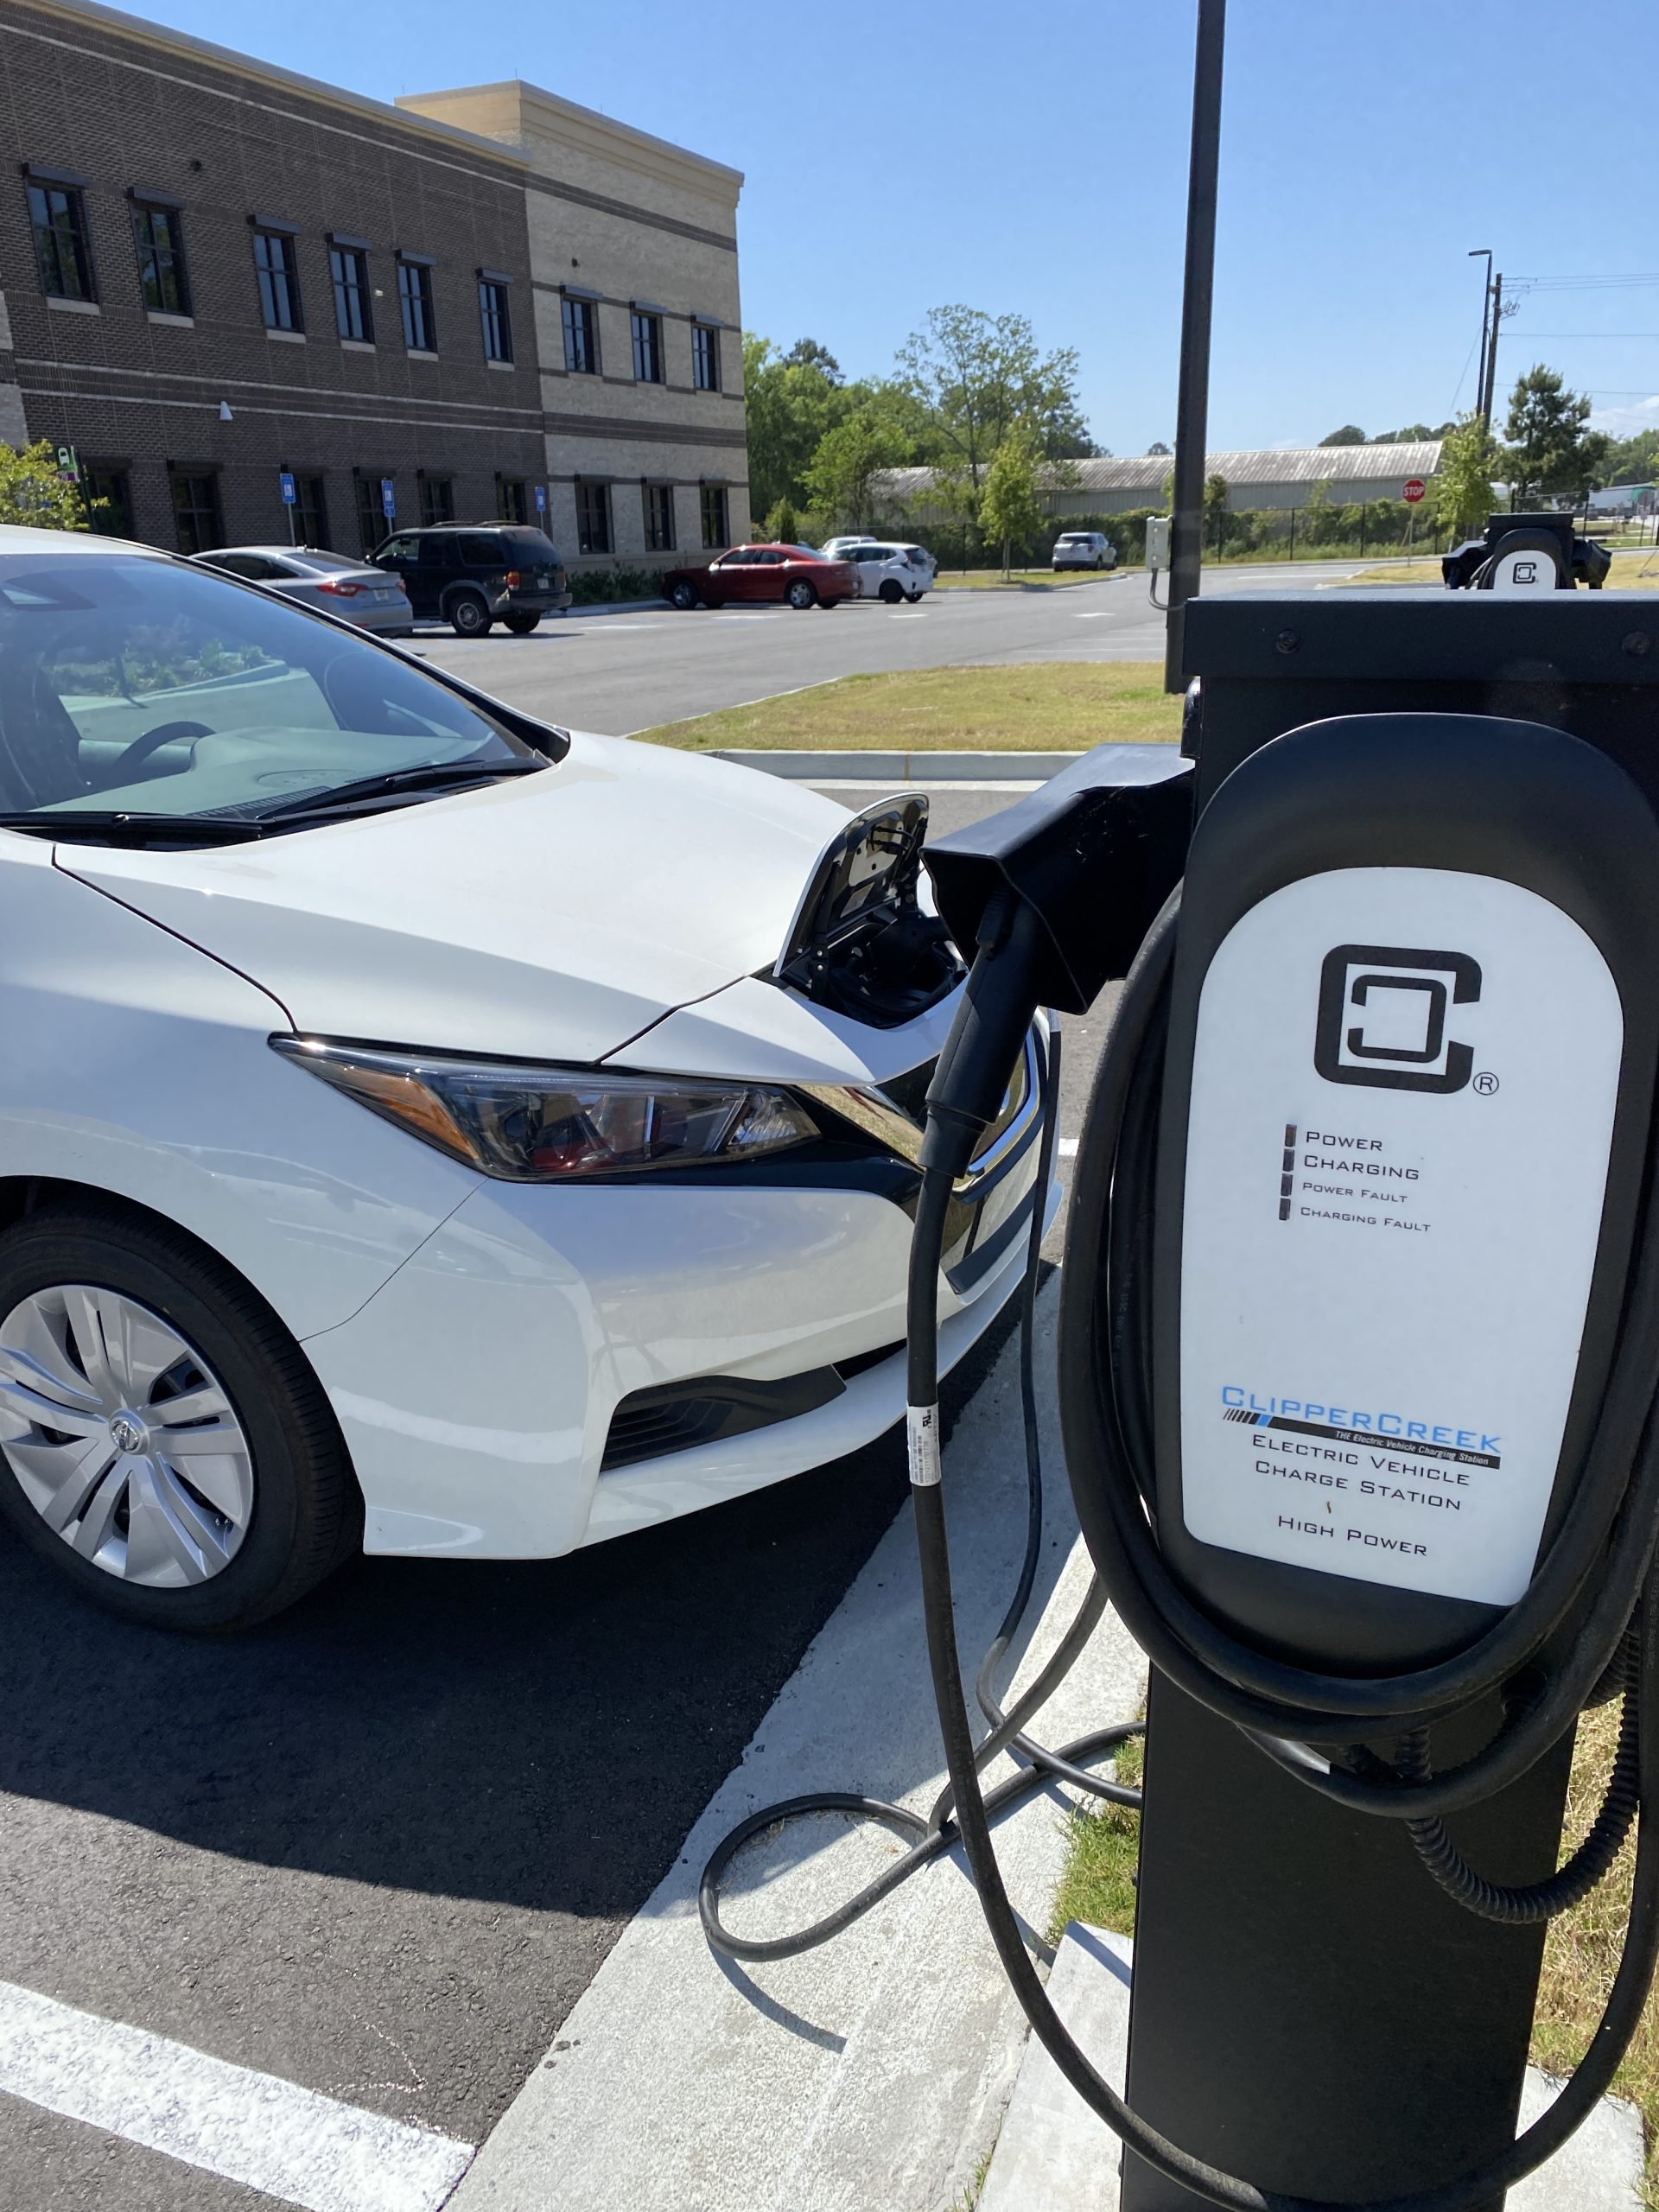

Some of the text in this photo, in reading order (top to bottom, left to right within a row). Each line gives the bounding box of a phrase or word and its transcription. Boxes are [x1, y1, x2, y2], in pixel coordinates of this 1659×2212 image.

[1403, 486, 1425, 497] STOP
[1306, 1131, 1382, 1152] POWER
[1304, 1154, 1420, 1180] CHARGING
[1302, 1181, 1408, 1204] POWER FAULT
[1300, 1207, 1432, 1233] CHARGING FAULT
[1253, 1434, 1471, 1486] ELECTRIC VEHICLE
[1335, 1430, 1490, 1466] THE Electric Vehicle Charging Station
[1255, 1460, 1461, 1510] CHARGE STATION
[1278, 1516, 1427, 1556] HIGH POWER
